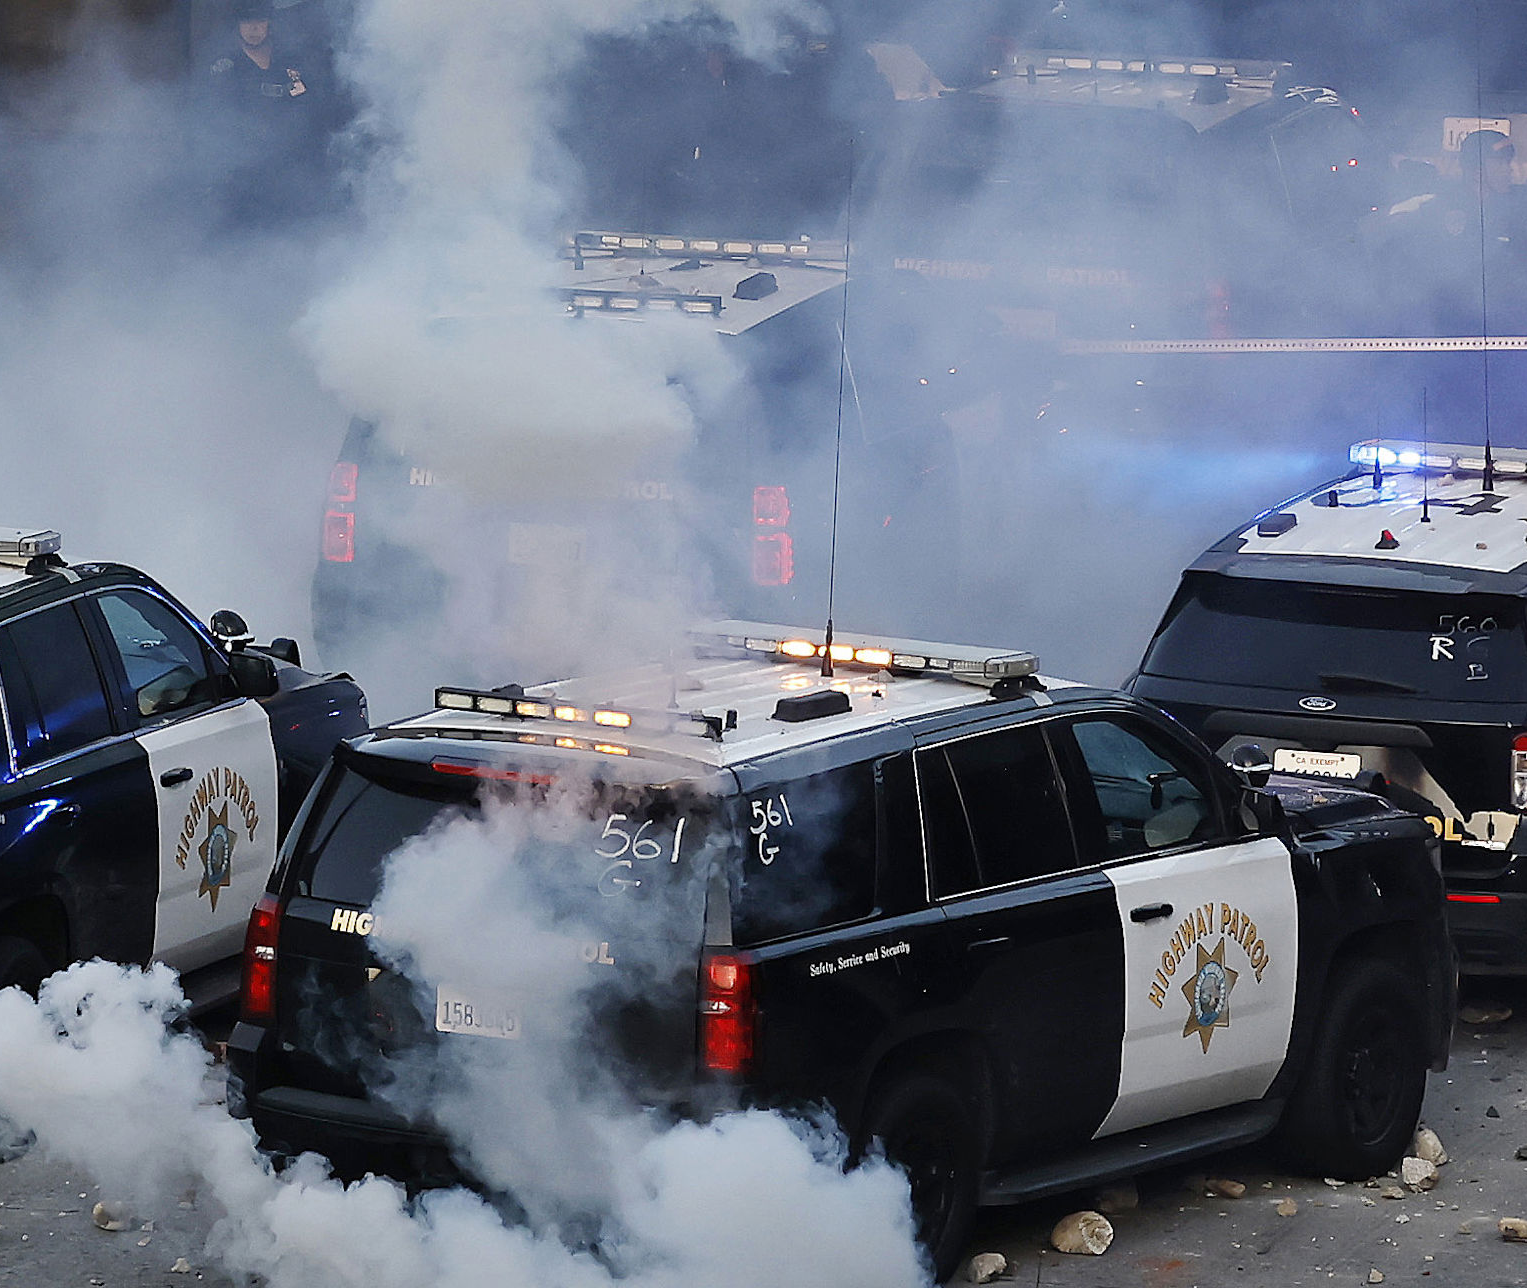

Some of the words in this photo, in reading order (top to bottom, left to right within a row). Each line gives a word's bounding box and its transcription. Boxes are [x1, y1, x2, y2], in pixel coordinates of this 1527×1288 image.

[1429, 636, 1455, 660] R
[1310, 758, 1339, 766] EXEMPT
[175, 766, 220, 870] HIGHWAY
[224, 766, 259, 842] PATROL
[594, 813, 686, 864] 561
[750, 793, 794, 835] 561
[809, 961, 837, 977] Safety,
[837, 953, 863, 970] Service
[864, 947, 879, 962] and
[880, 940, 911, 959] Security
[1148, 902, 1214, 1010] HIGHWAY
[1220, 902, 1270, 985] PATROL
